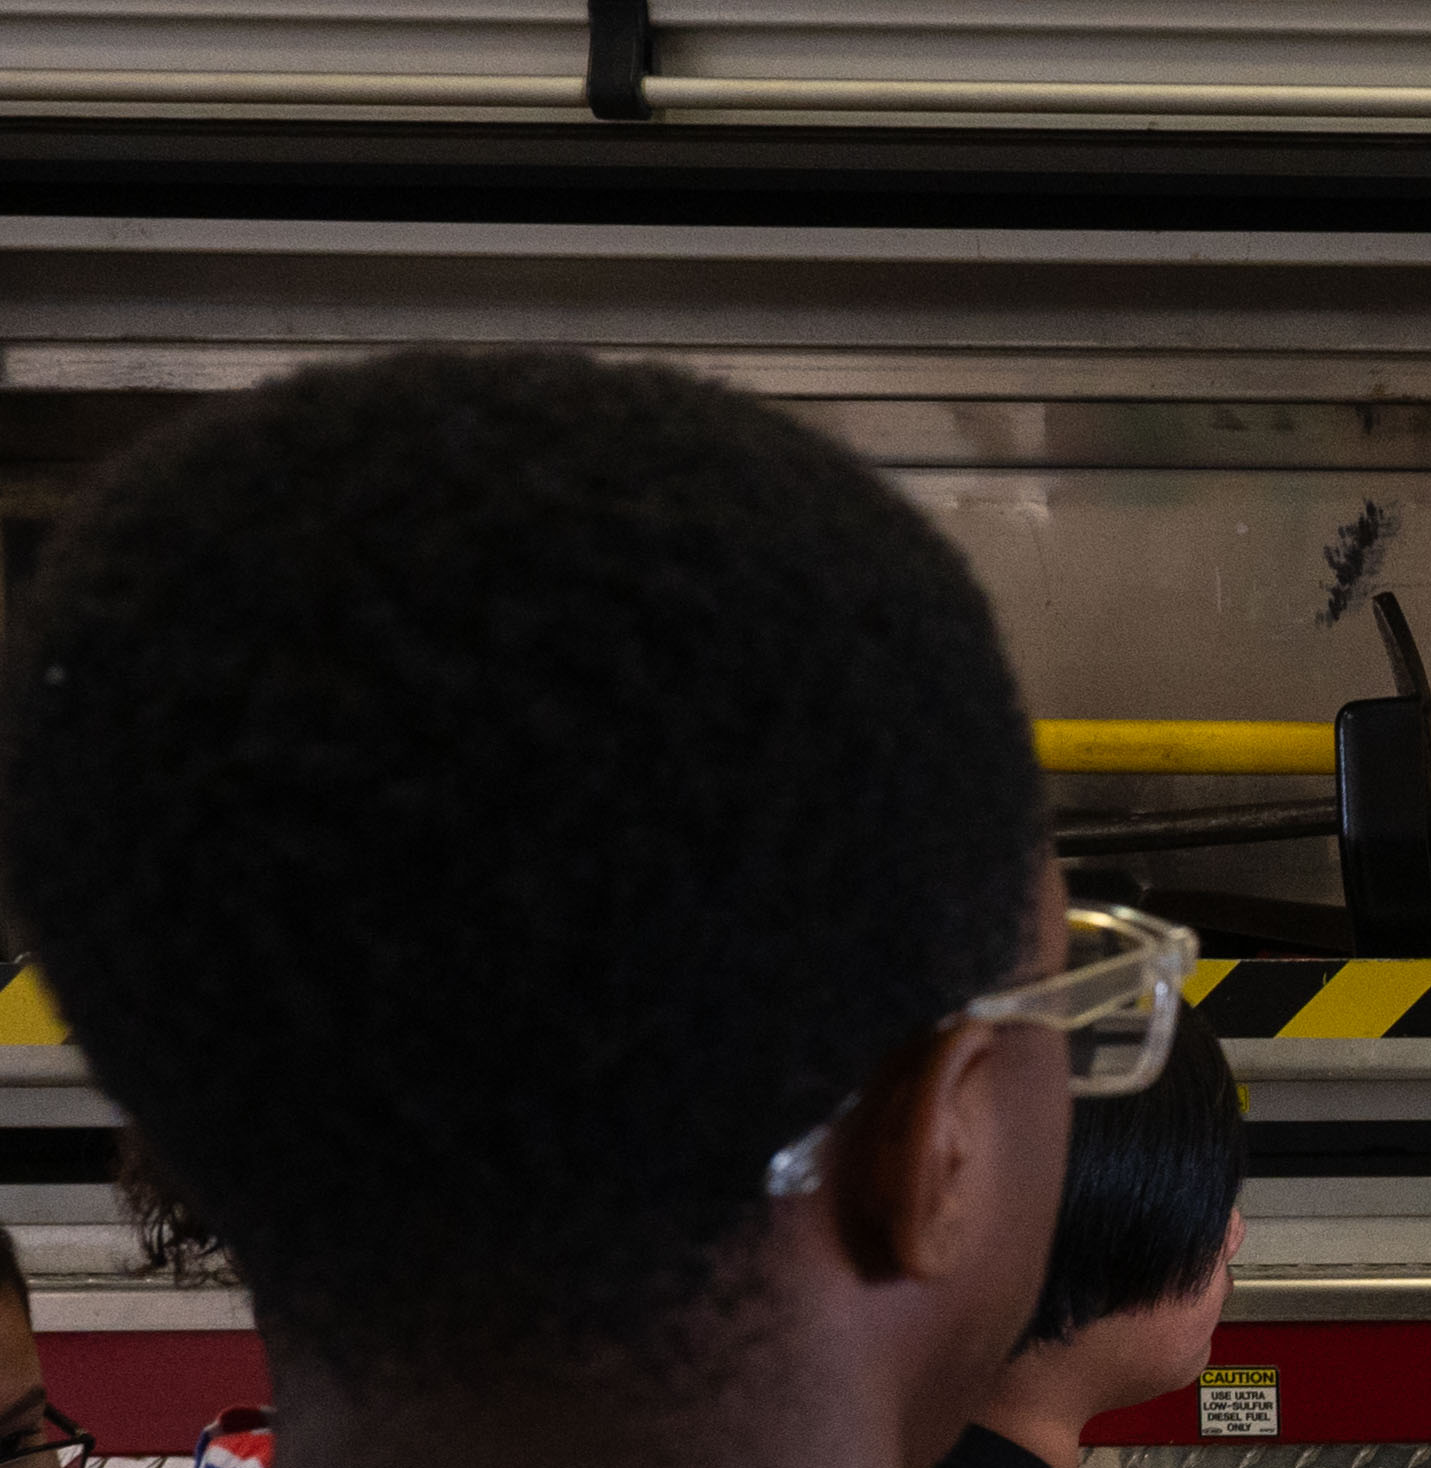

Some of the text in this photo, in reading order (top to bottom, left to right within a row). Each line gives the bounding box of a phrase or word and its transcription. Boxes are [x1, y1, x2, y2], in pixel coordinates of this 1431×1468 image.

[1202, 1371, 1274, 1384] CAUTION
[1211, 1391, 1265, 1400] USE ULTRA
[1203, 1402, 1273, 1411] LOW-SULFUR
[1208, 1412, 1271, 1421] DIESEL FUEL
[1227, 1423, 1252, 1432] ONLY
